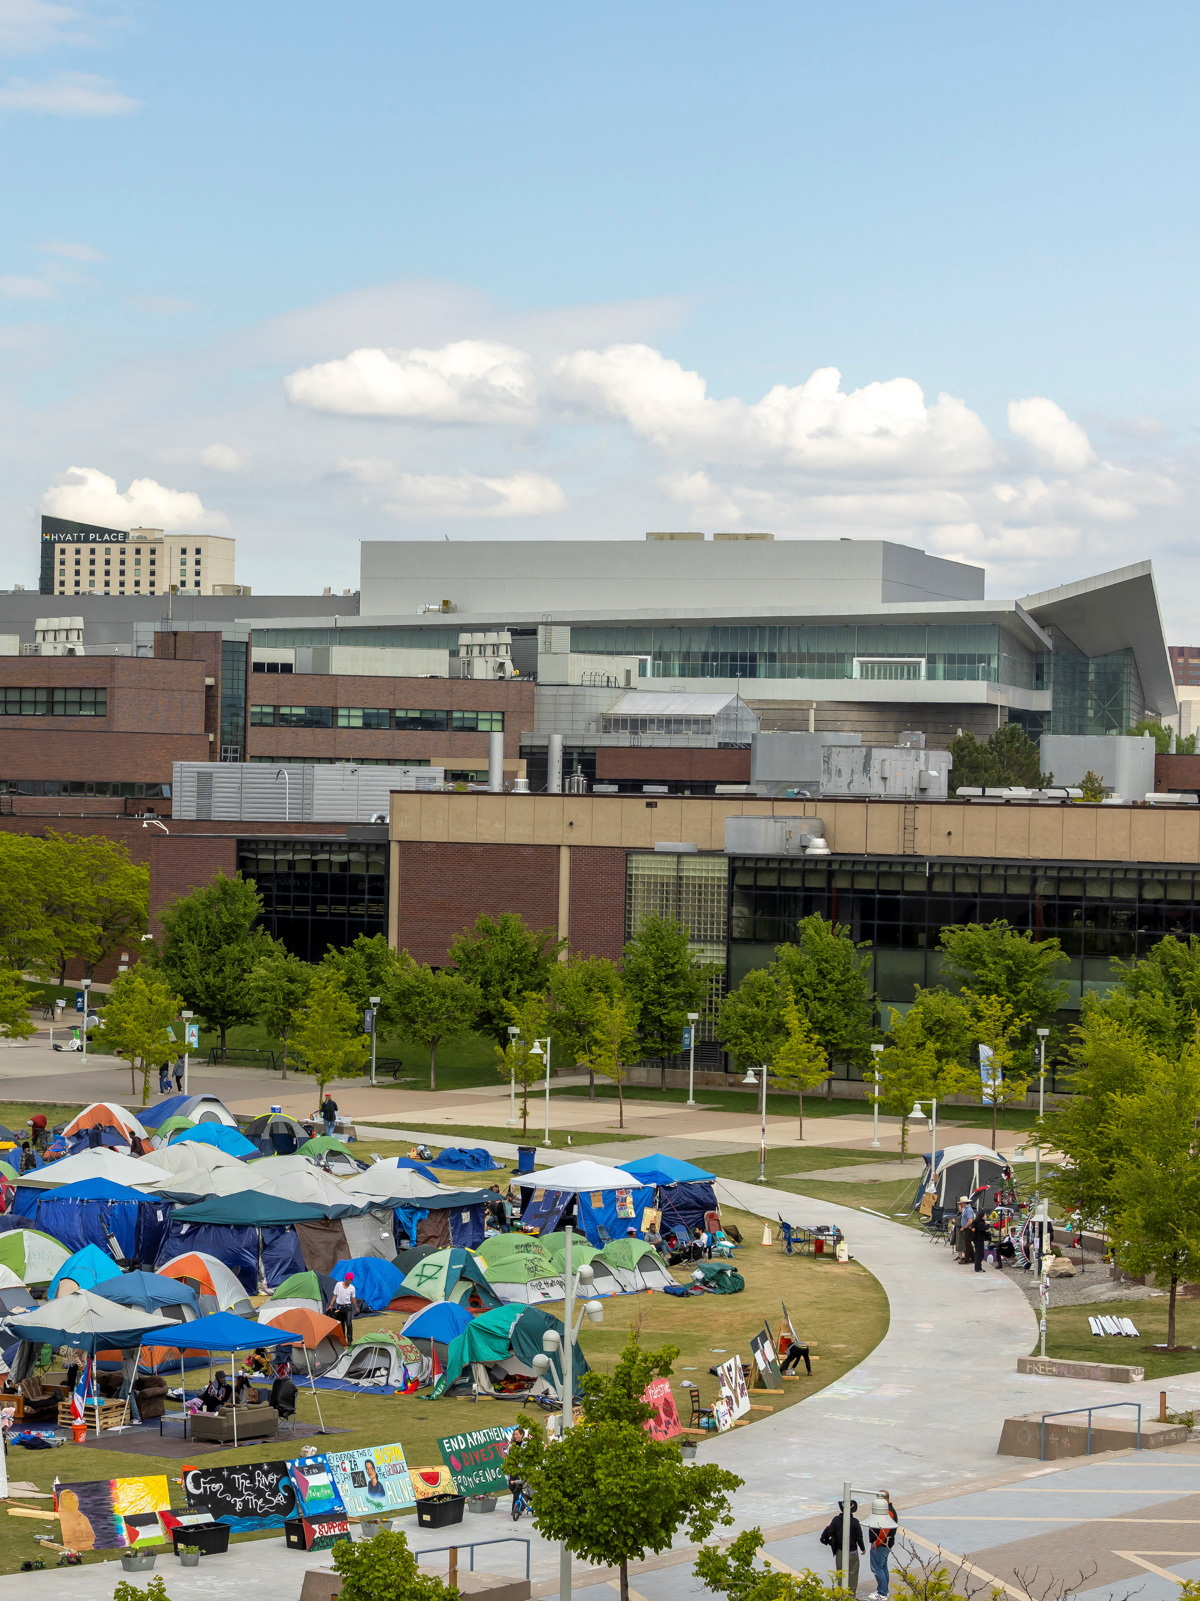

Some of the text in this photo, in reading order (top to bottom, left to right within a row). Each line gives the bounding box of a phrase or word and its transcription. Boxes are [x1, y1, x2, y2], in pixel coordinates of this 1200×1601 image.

[51, 533, 125, 541] HYATT PLACE
[530, 1281, 545, 1290] Free
[1026, 1361, 1053, 1375] FREE
[443, 1435, 466, 1452] END
[356, 1448, 368, 1459] THIS
[373, 1444, 403, 1466] BISAN
[461, 1443, 502, 1466] DIVEST
[384, 1461, 407, 1477] GENOCIDE
[230, 1472, 253, 1491] The
[254, 1470, 281, 1490] River
[452, 1475, 476, 1492] FROM
[472, 1467, 502, 1484] GENOC
[384, 1477, 416, 1506] ALIVE
[231, 1497, 244, 1512] To
[265, 1491, 287, 1509] Sea
[317, 1520, 349, 1536] SUPPORT
